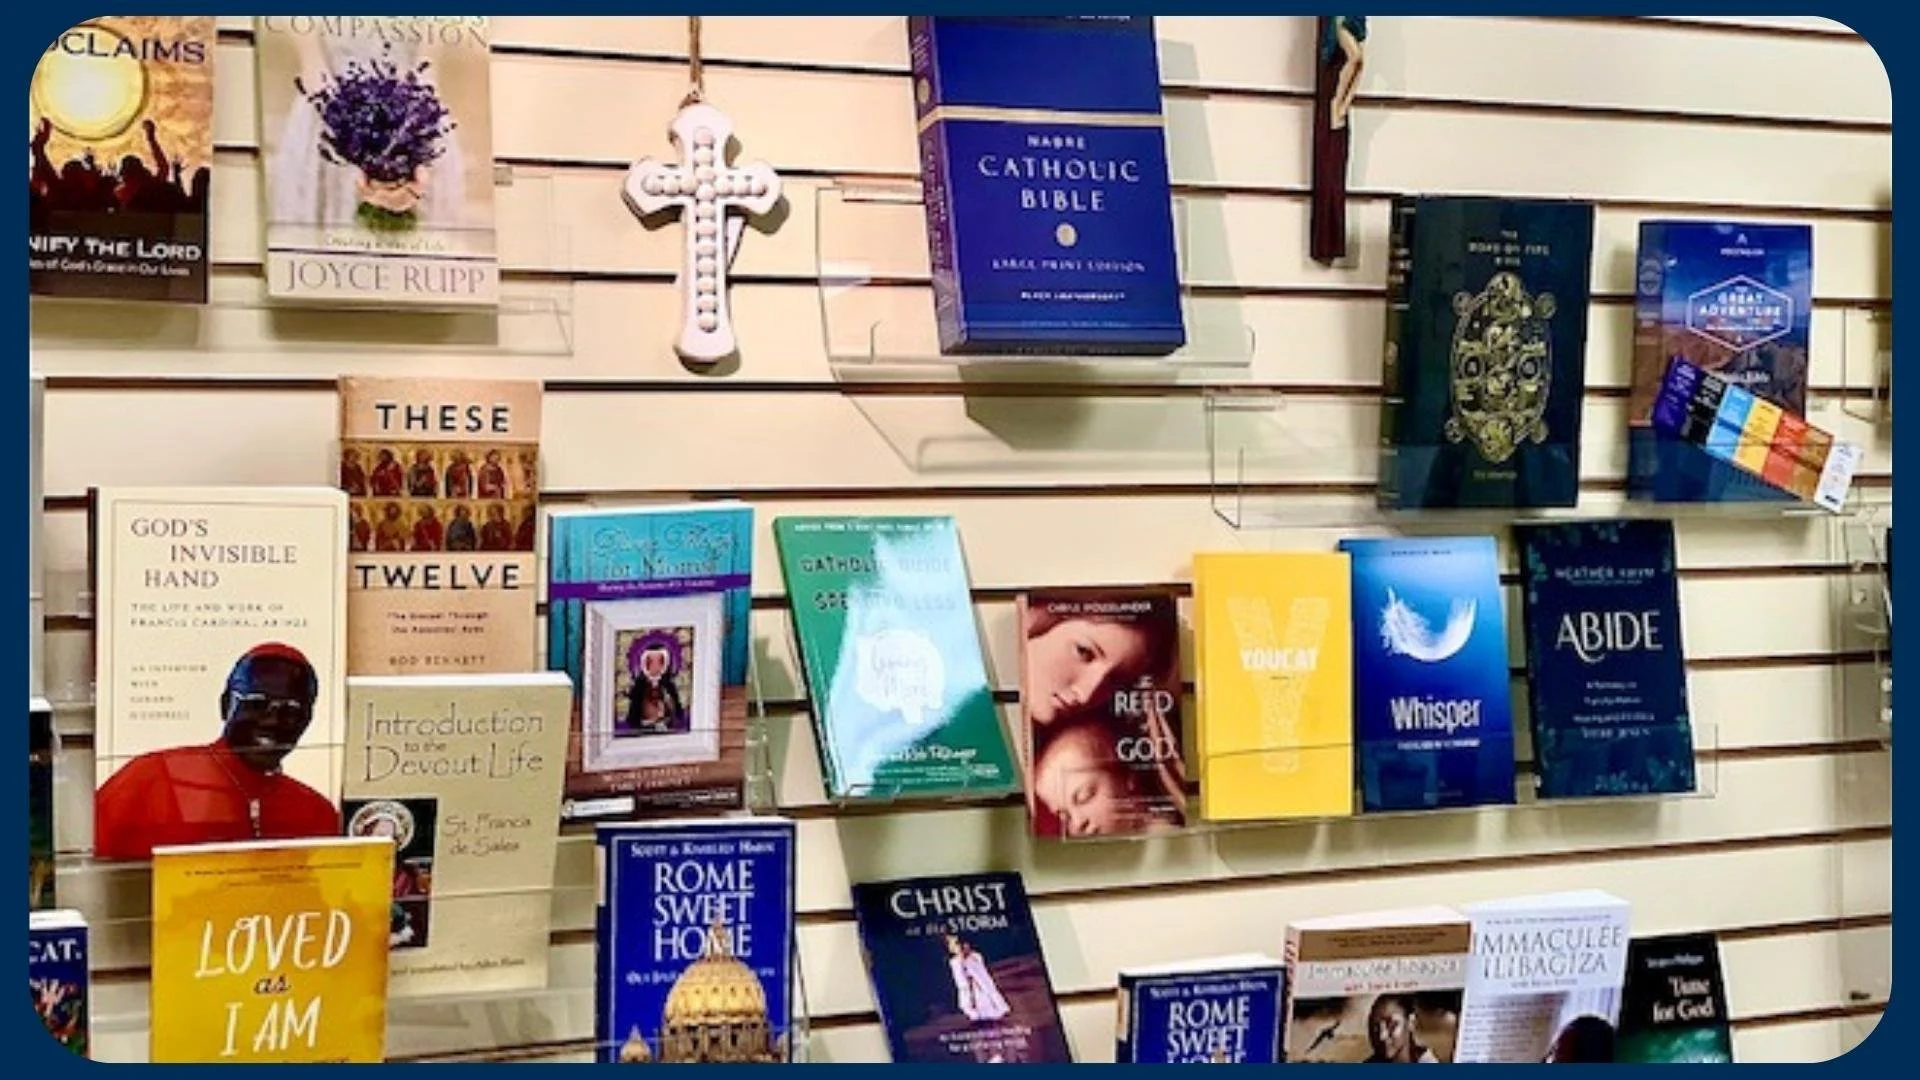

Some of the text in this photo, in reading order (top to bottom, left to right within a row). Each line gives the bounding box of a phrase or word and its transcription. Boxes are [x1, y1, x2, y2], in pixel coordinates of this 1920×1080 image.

[265, 16, 488, 48] COMPASSION
[53, 32, 206, 63] CLAIMS
[1027, 134, 1087, 150] NABRE
[978, 154, 1141, 183] CATHOLIC
[1020, 188, 1106, 212] BIBLE
[84, 236, 132, 258] THE
[136, 238, 202, 261] LORD
[286, 260, 484, 294] JOYCE RUPP
[1042, 260, 1082, 272] PRINT
[374, 404, 510, 432] THESE
[130, 518, 209, 538] GOD'S
[169, 543, 298, 565] INVISIBLE
[143, 568, 220, 589] HAND
[355, 564, 520, 590] TWELVE
[1554, 610, 1664, 664] ABIDE
[1240, 647, 1319, 672] YOUCAT
[1114, 690, 1175, 715] REED
[1391, 696, 1482, 735] Whisper
[365, 702, 544, 741] Introduction
[363, 740, 545, 783] Devout Life
[403, 742, 419, 753] to
[1117, 737, 1173, 762] GOD
[654, 859, 755, 893] ROME
[652, 891, 755, 926] SWEET
[890, 882, 1006, 919] CHRIST
[949, 914, 1009, 934] STORM
[194, 907, 352, 979] LOVED
[654, 924, 752, 962] HOME
[1483, 951, 1608, 980] ILIBAGIZA
[253, 973, 292, 995] as
[1169, 996, 1250, 1031] ROME
[1676, 995, 1716, 1021] God
[220, 995, 322, 1057] I AM
[1167, 1025, 1249, 1055] SWEET
